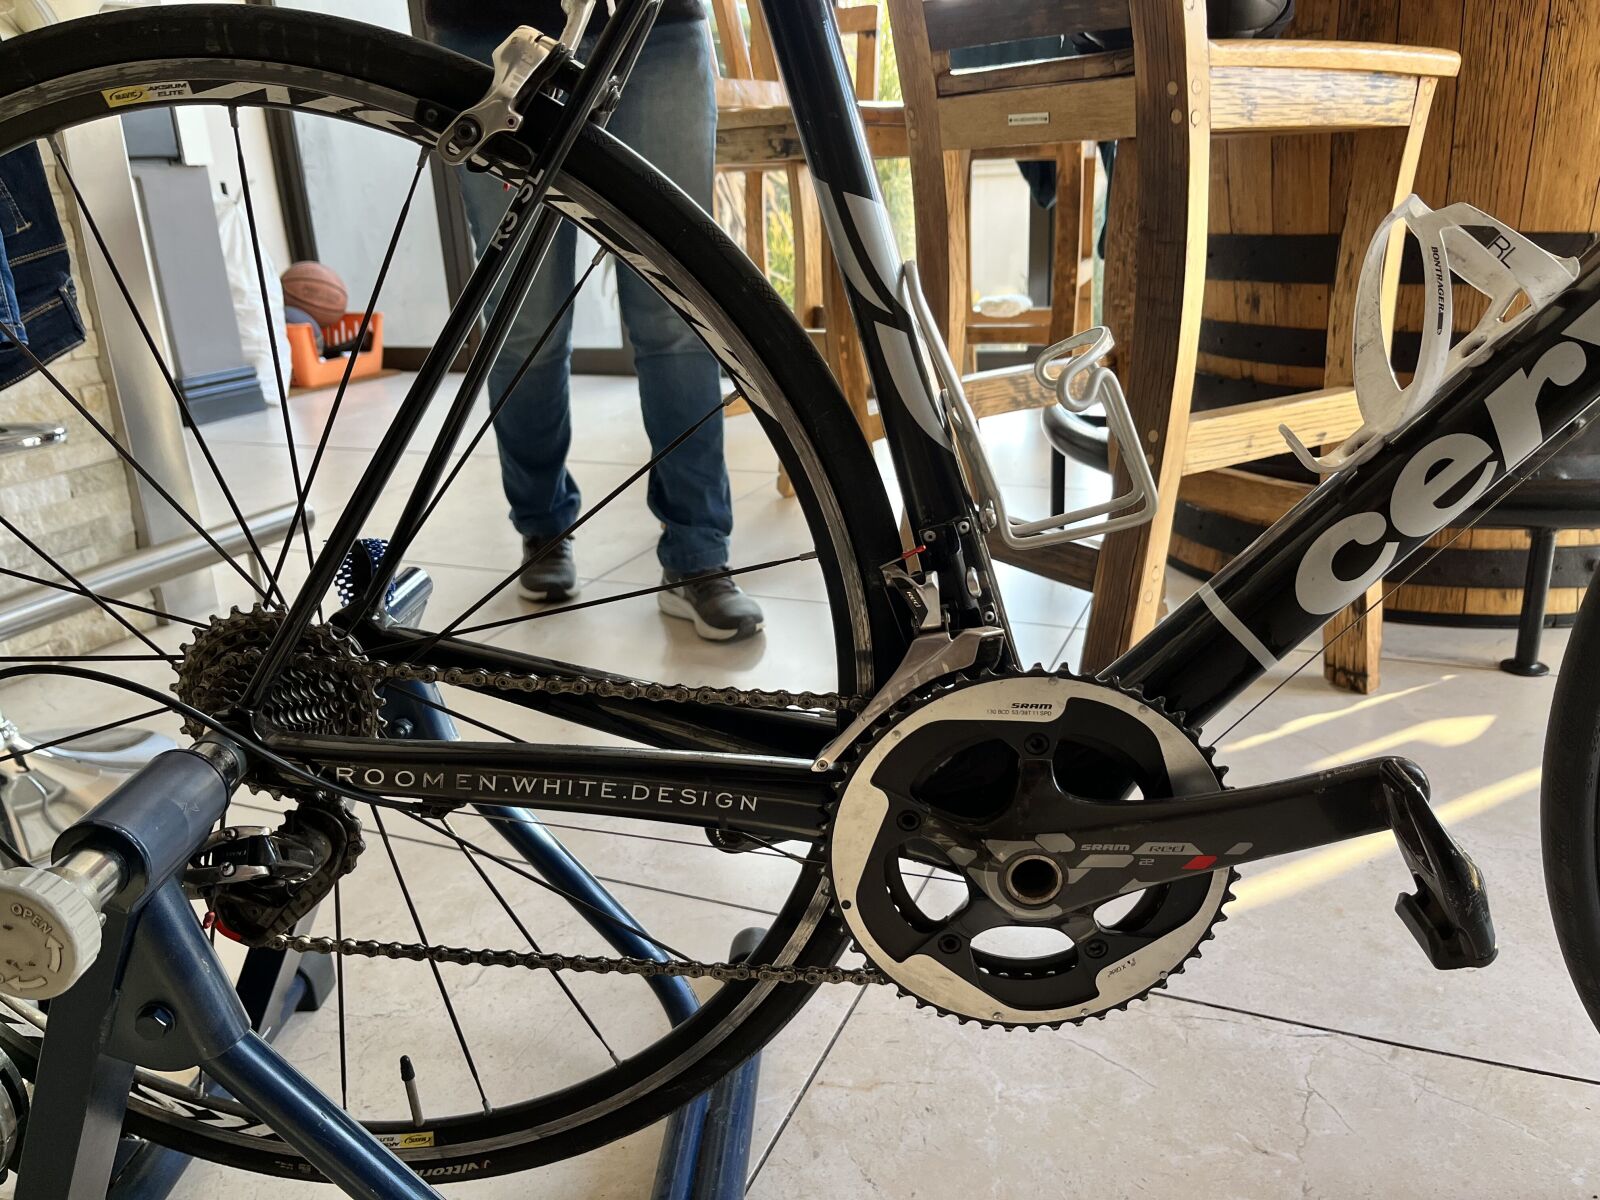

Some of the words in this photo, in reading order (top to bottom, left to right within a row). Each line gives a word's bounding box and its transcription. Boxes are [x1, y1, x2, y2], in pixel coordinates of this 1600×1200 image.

[146, 82, 188, 92] AKSIUM
[157, 90, 185, 98] ELITE
[490, 210, 518, 252] R3
[516, 168, 545, 204] SL
[1486, 234, 1516, 270] RL
[1430, 246, 1445, 313] BONTRAGER
[1295, 302, 1600, 615] cer
[1011, 702, 1053, 710] SRAM
[1080, 843, 1131, 851] SRAM
[10, 903, 53, 935] OPEN
